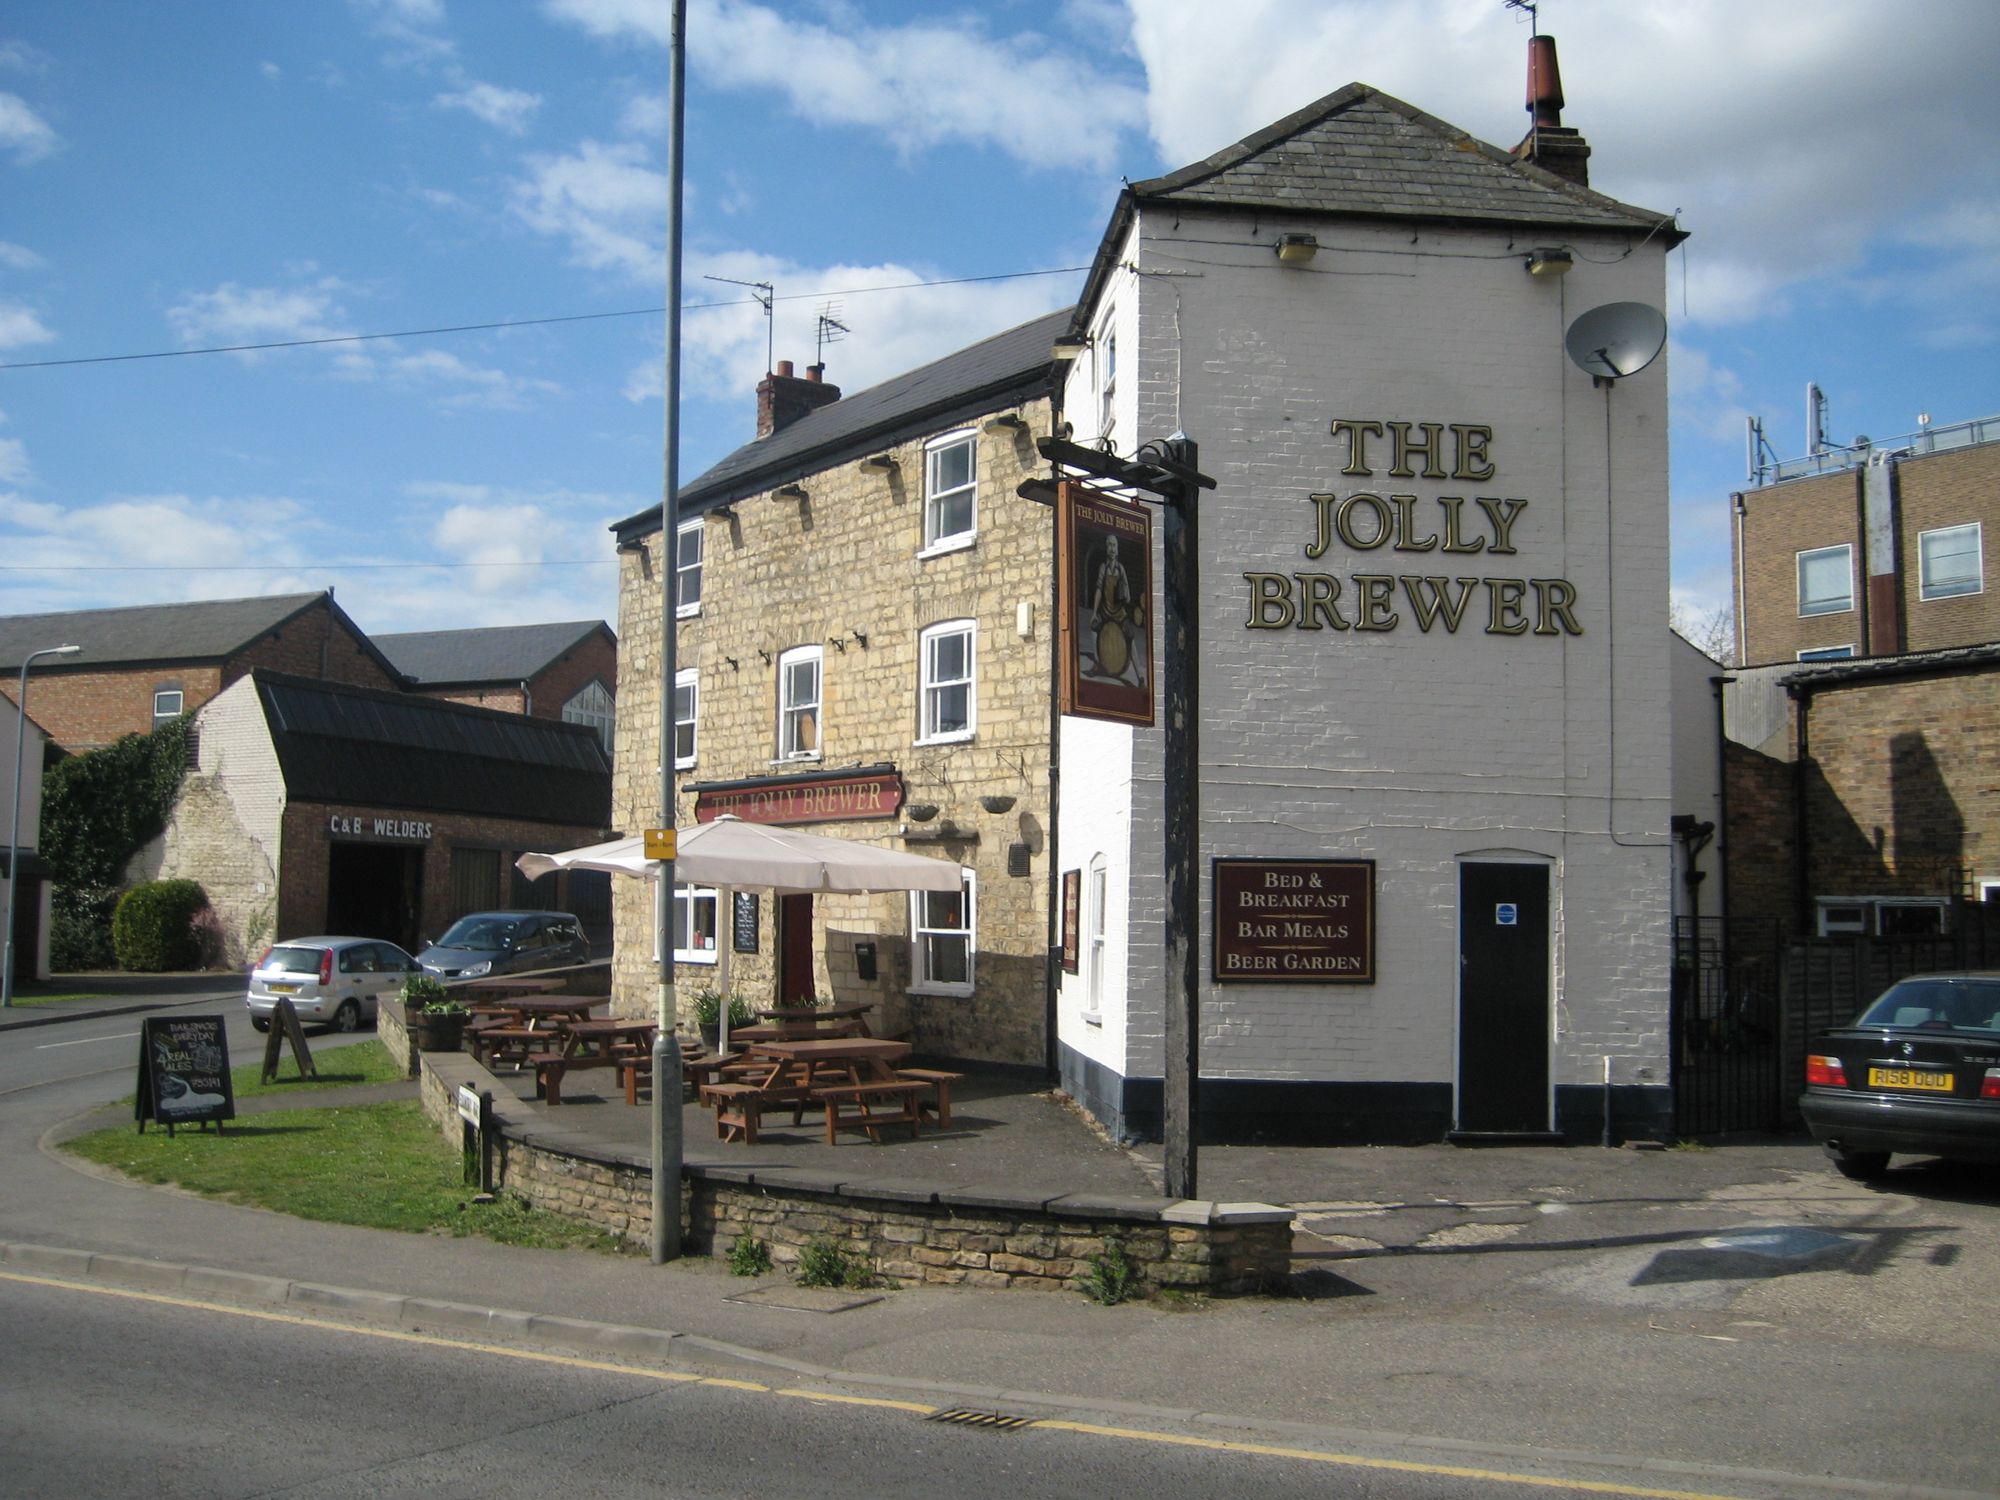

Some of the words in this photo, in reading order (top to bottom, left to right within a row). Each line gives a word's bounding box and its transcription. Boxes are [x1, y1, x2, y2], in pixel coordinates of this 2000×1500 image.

[1331, 419, 1496, 481] THE
[1076, 504, 1092, 519] THE
[1094, 509, 1114, 526] JOLLY
[1115, 516, 1145, 535] BREWER
[1304, 493, 1528, 559] JOLLY
[1243, 572, 1585, 636] BREWER
[712, 794, 743, 815] THE
[750, 789, 798, 817] JOLLY
[803, 782, 881, 814] BREWER
[374, 818, 433, 839] WELDERS
[1264, 872, 1303, 888] BED
[1309, 872, 1324, 888] &
[1239, 891, 1350, 908] BREAKFAST
[1238, 921, 1277, 938] BAR
[1283, 922, 1349, 938] MEALS
[1226, 953, 1277, 969] BEER
[1283, 953, 1361, 970] GARDEN
